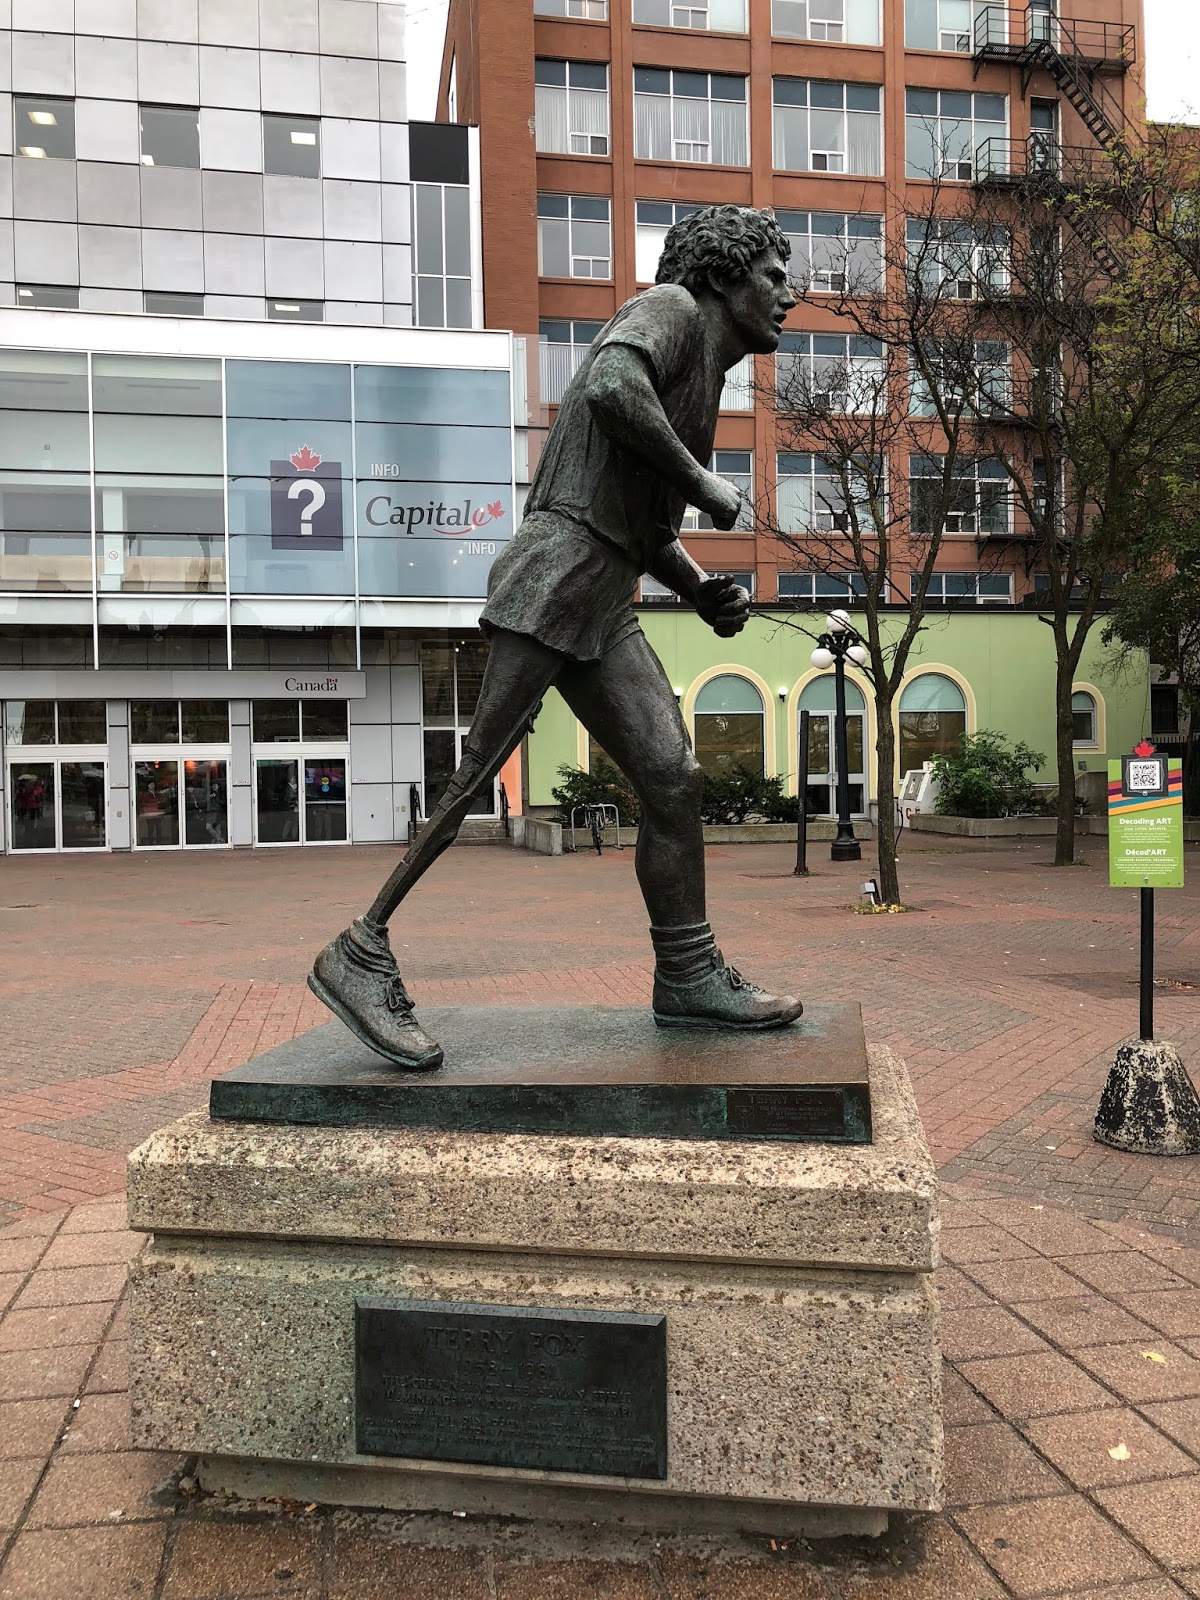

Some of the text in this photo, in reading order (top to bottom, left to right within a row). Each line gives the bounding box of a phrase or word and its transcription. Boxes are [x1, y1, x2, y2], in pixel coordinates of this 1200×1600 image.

[371, 463, 400, 477] INFO
[366, 496, 494, 535] Capitale
[468, 543, 496, 555] INFO
[285, 677, 338, 692] Canada
[1119, 818, 1154, 827] Decoding
[747, 1093, 788, 1104] TERRY
[428, 1326, 586, 1358] TERRY FOX
